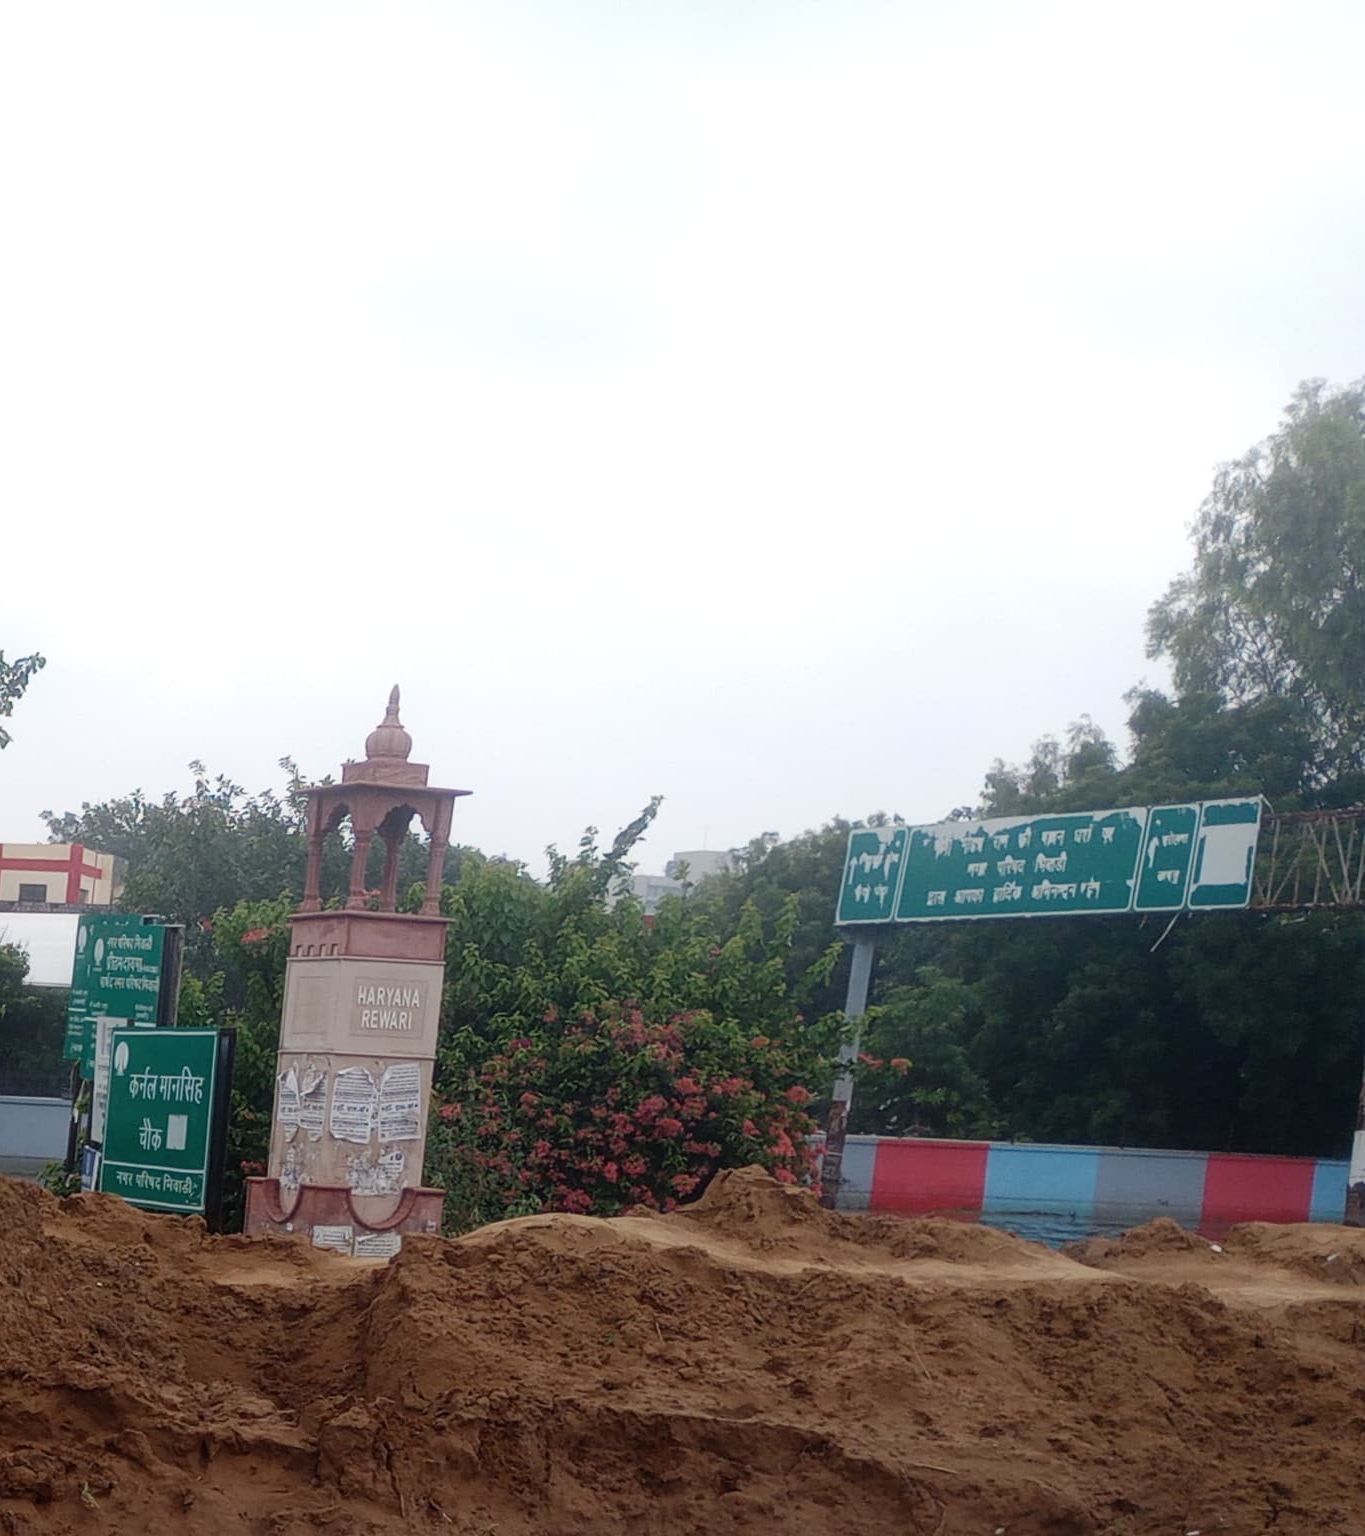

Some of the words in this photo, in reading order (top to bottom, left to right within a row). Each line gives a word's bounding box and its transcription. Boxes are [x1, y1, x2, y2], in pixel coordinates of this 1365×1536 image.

[357, 986, 421, 1008] HARYANA
[361, 1010, 412, 1030] REWARI
[129, 1066, 158, 1100] कर्नल
[139, 1117, 163, 1151] चौक
